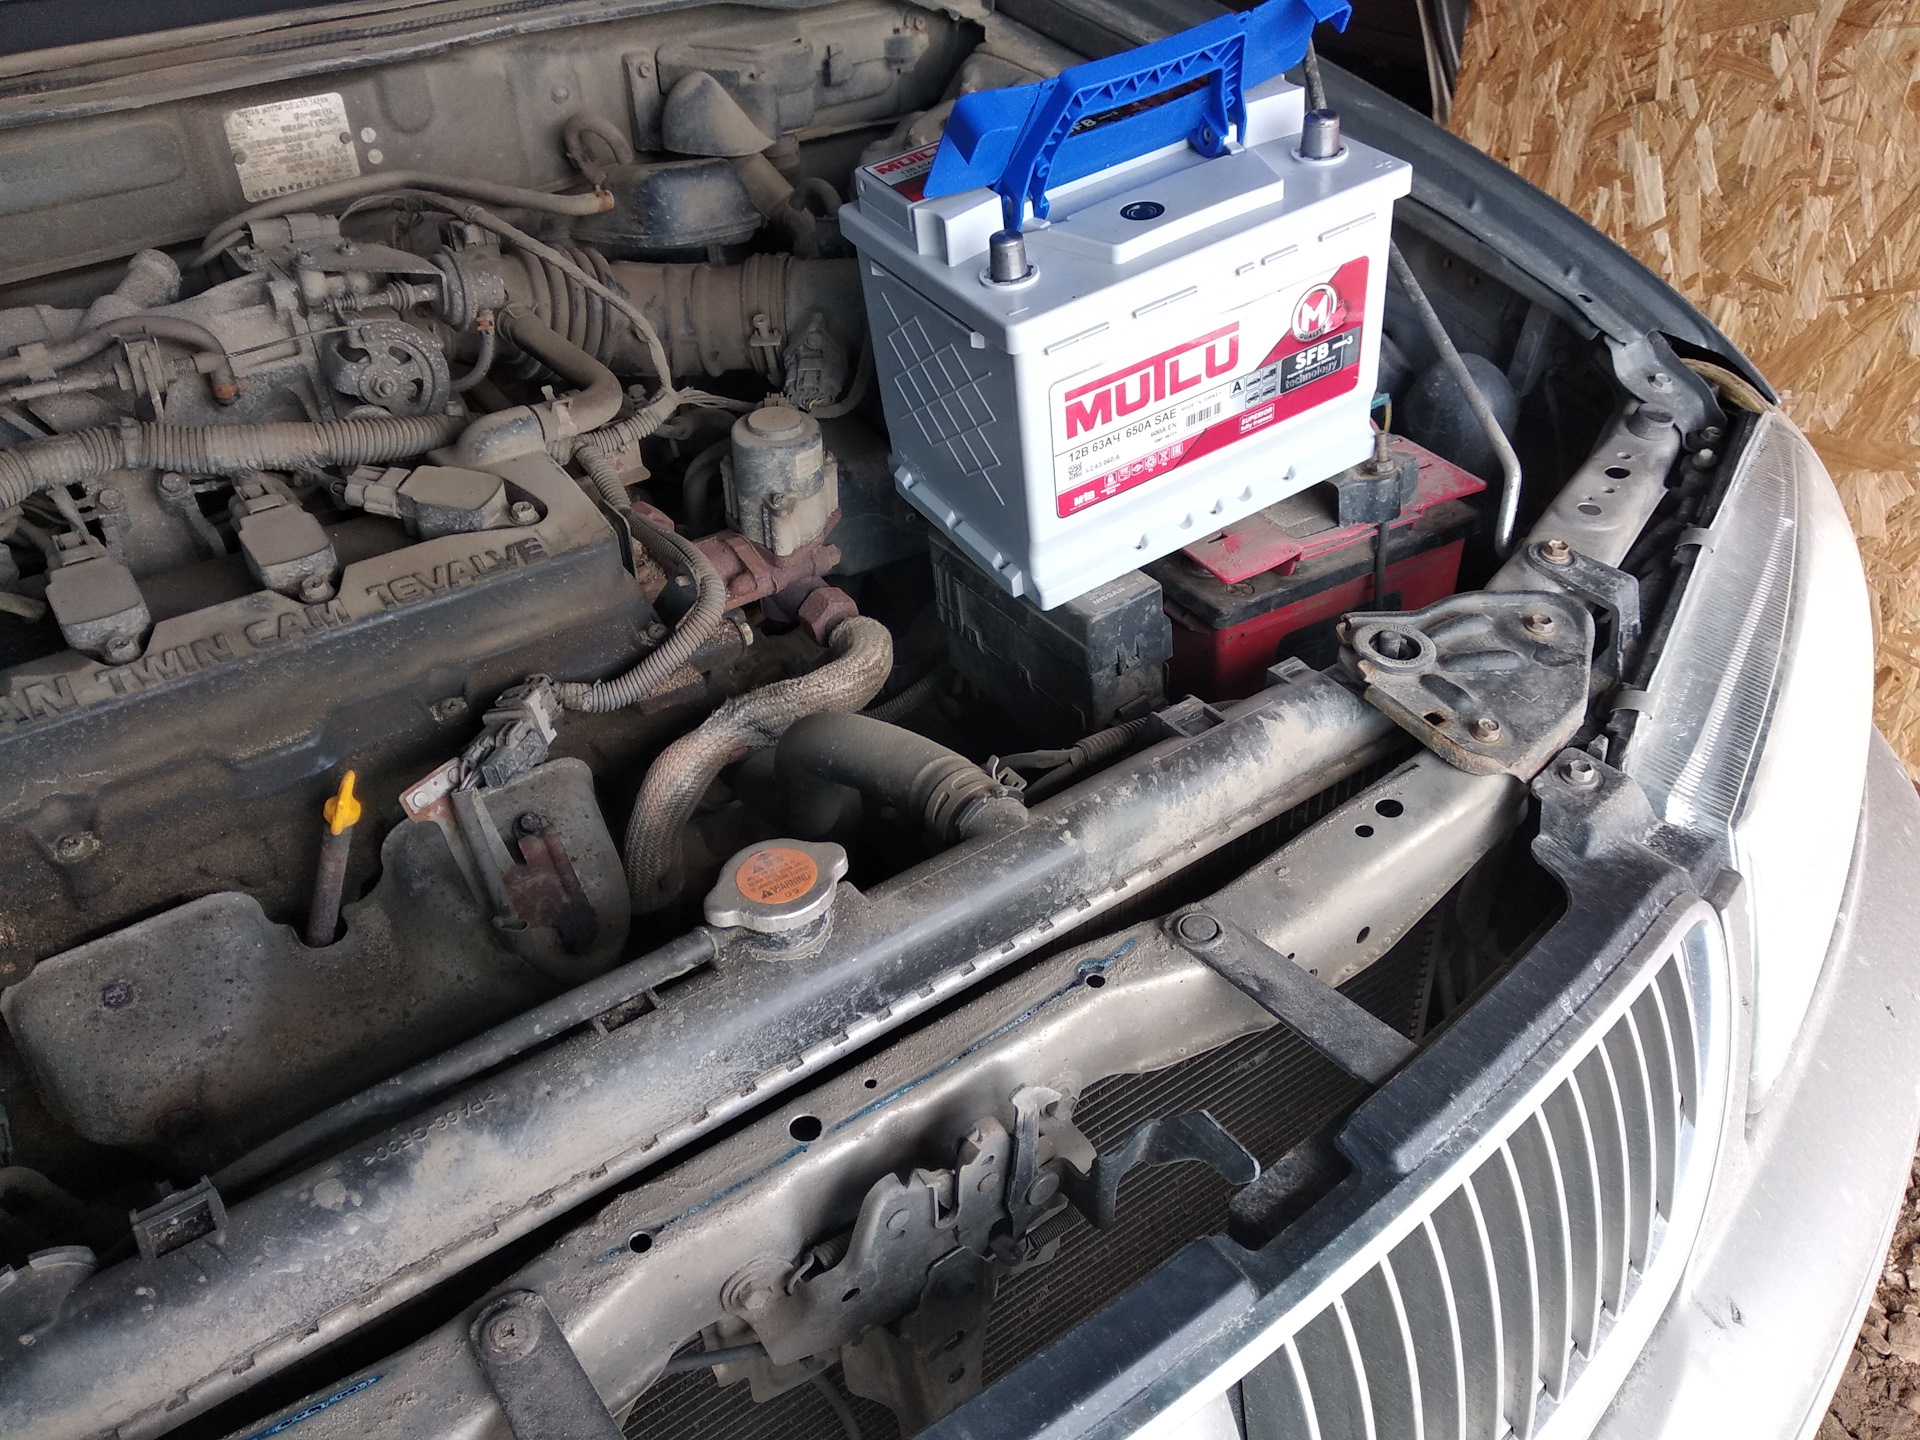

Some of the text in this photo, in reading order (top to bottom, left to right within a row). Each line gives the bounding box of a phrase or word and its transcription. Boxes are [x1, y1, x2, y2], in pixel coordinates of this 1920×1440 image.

[1299, 324, 1327, 340] QUALITY
[1295, 342, 1330, 370] SFB
[1065, 321, 1240, 440] MUTLU
[1285, 359, 1338, 389] technology
[1232, 381, 1242, 394] A
[1126, 420, 1152, 438] 650A
[1154, 408, 1177, 425] SAE
[1241, 406, 1273, 425] SUPERIOR
[1091, 587, 1126, 605] NISSAN
[95, 633, 236, 698] TWIN
[243, 597, 353, 651] CAM
[365, 537, 550, 610] 16VALVE
[770, 872, 811, 893] WARNING
